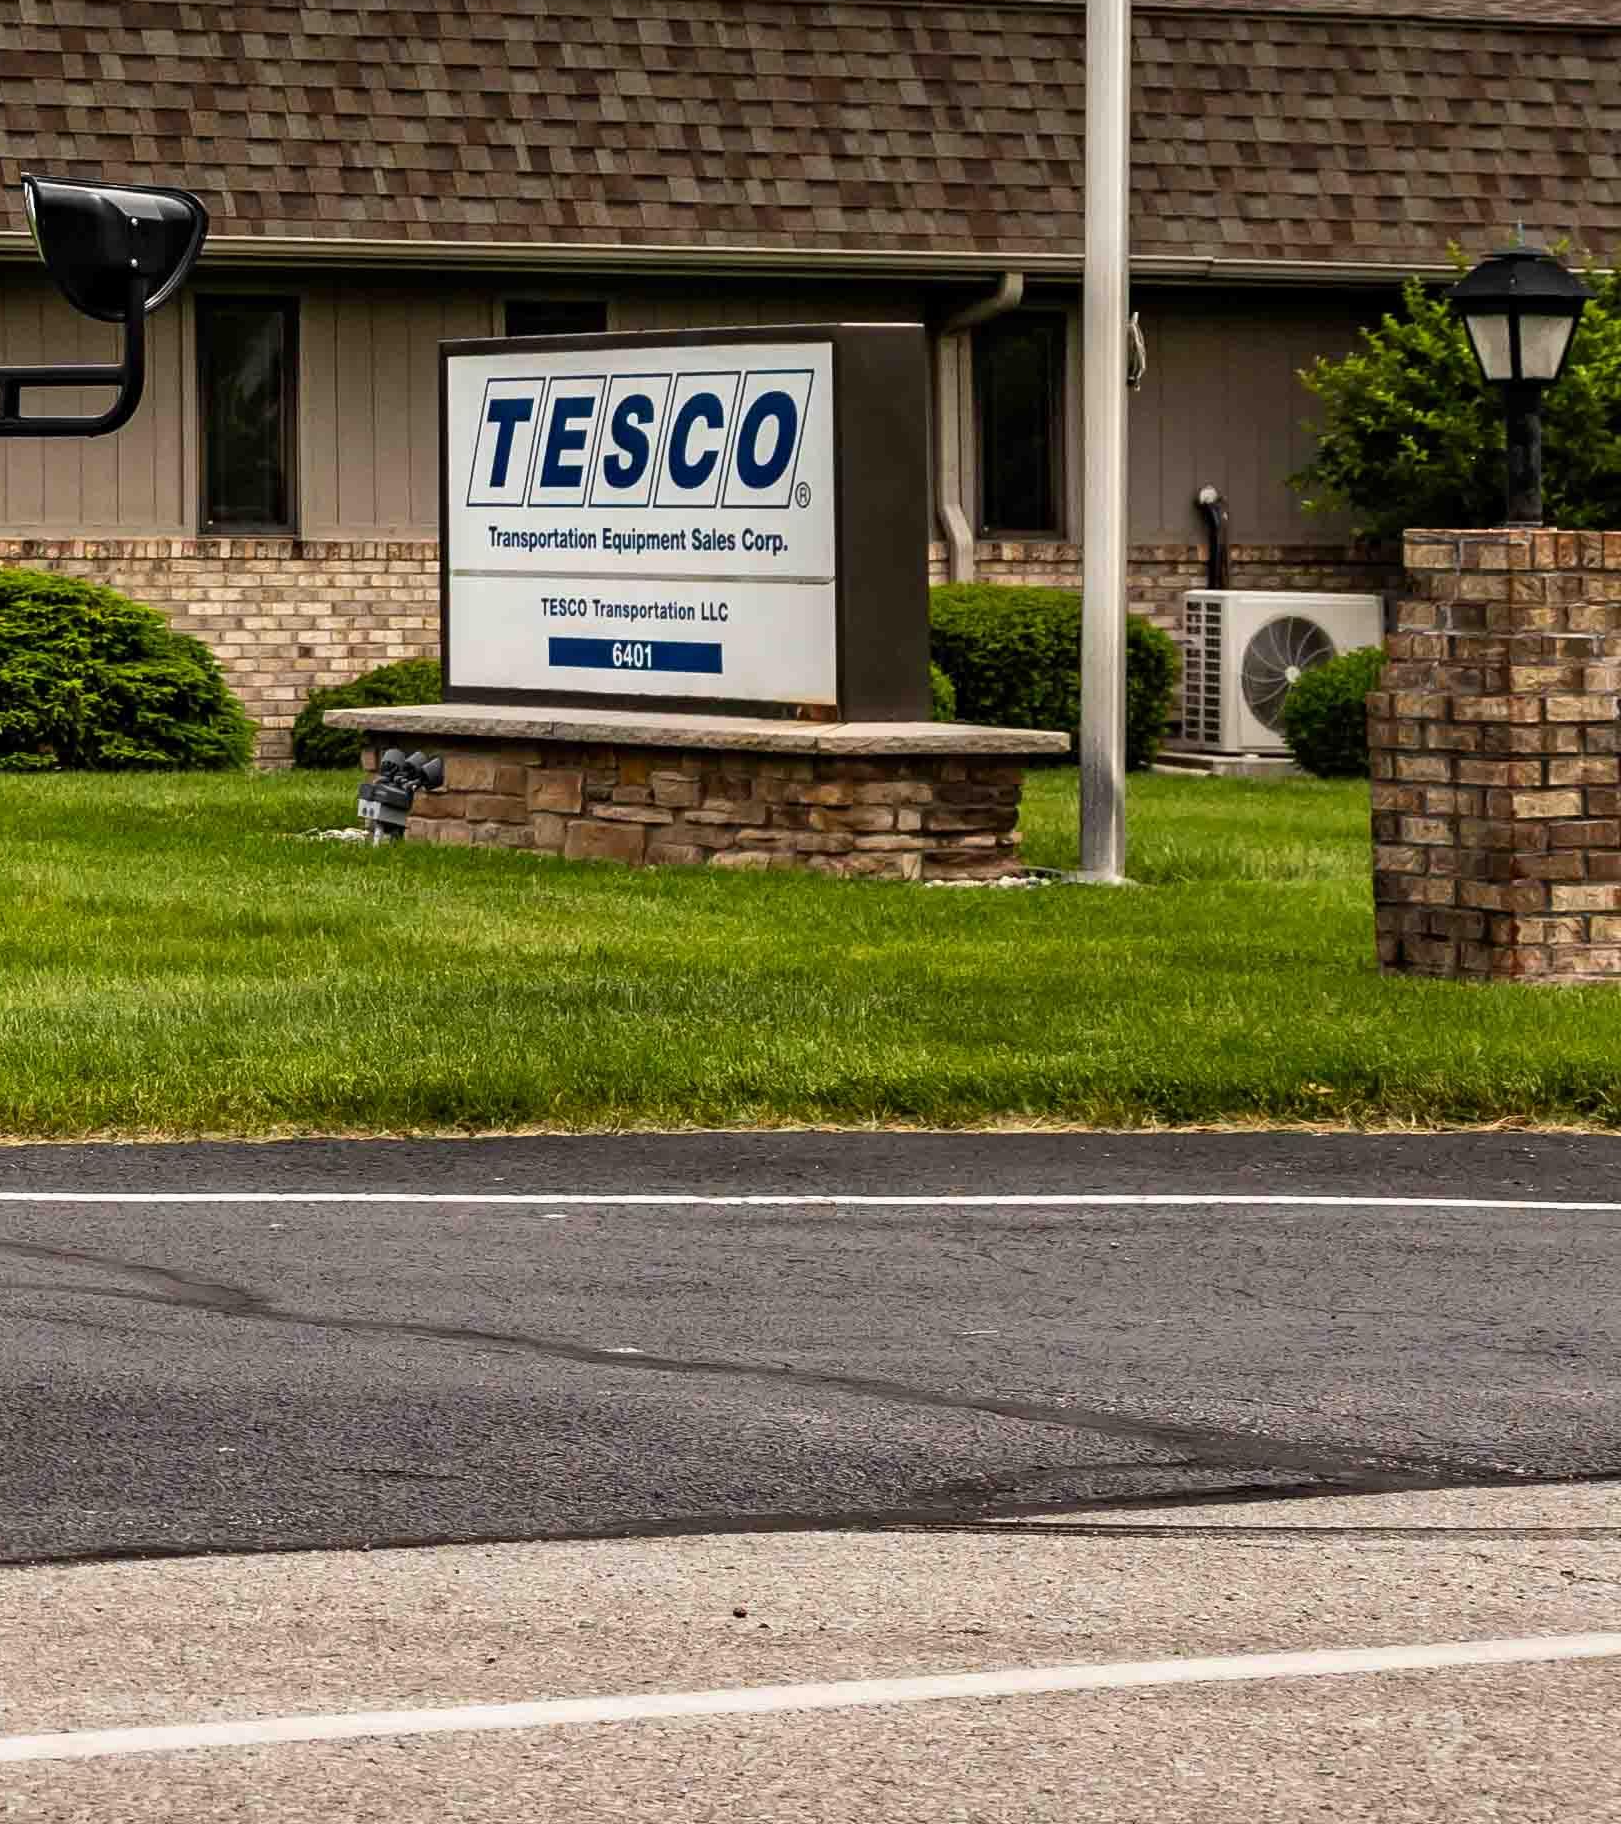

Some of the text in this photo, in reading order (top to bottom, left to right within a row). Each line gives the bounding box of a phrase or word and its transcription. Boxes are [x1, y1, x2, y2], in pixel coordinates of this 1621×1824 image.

[486, 391, 798, 490] TESCO
[488, 525, 789, 557] Transportation Equipment Sales Corp.
[540, 597, 729, 623] TESCO Transportation LLC
[612, 642, 653, 669] 6401
